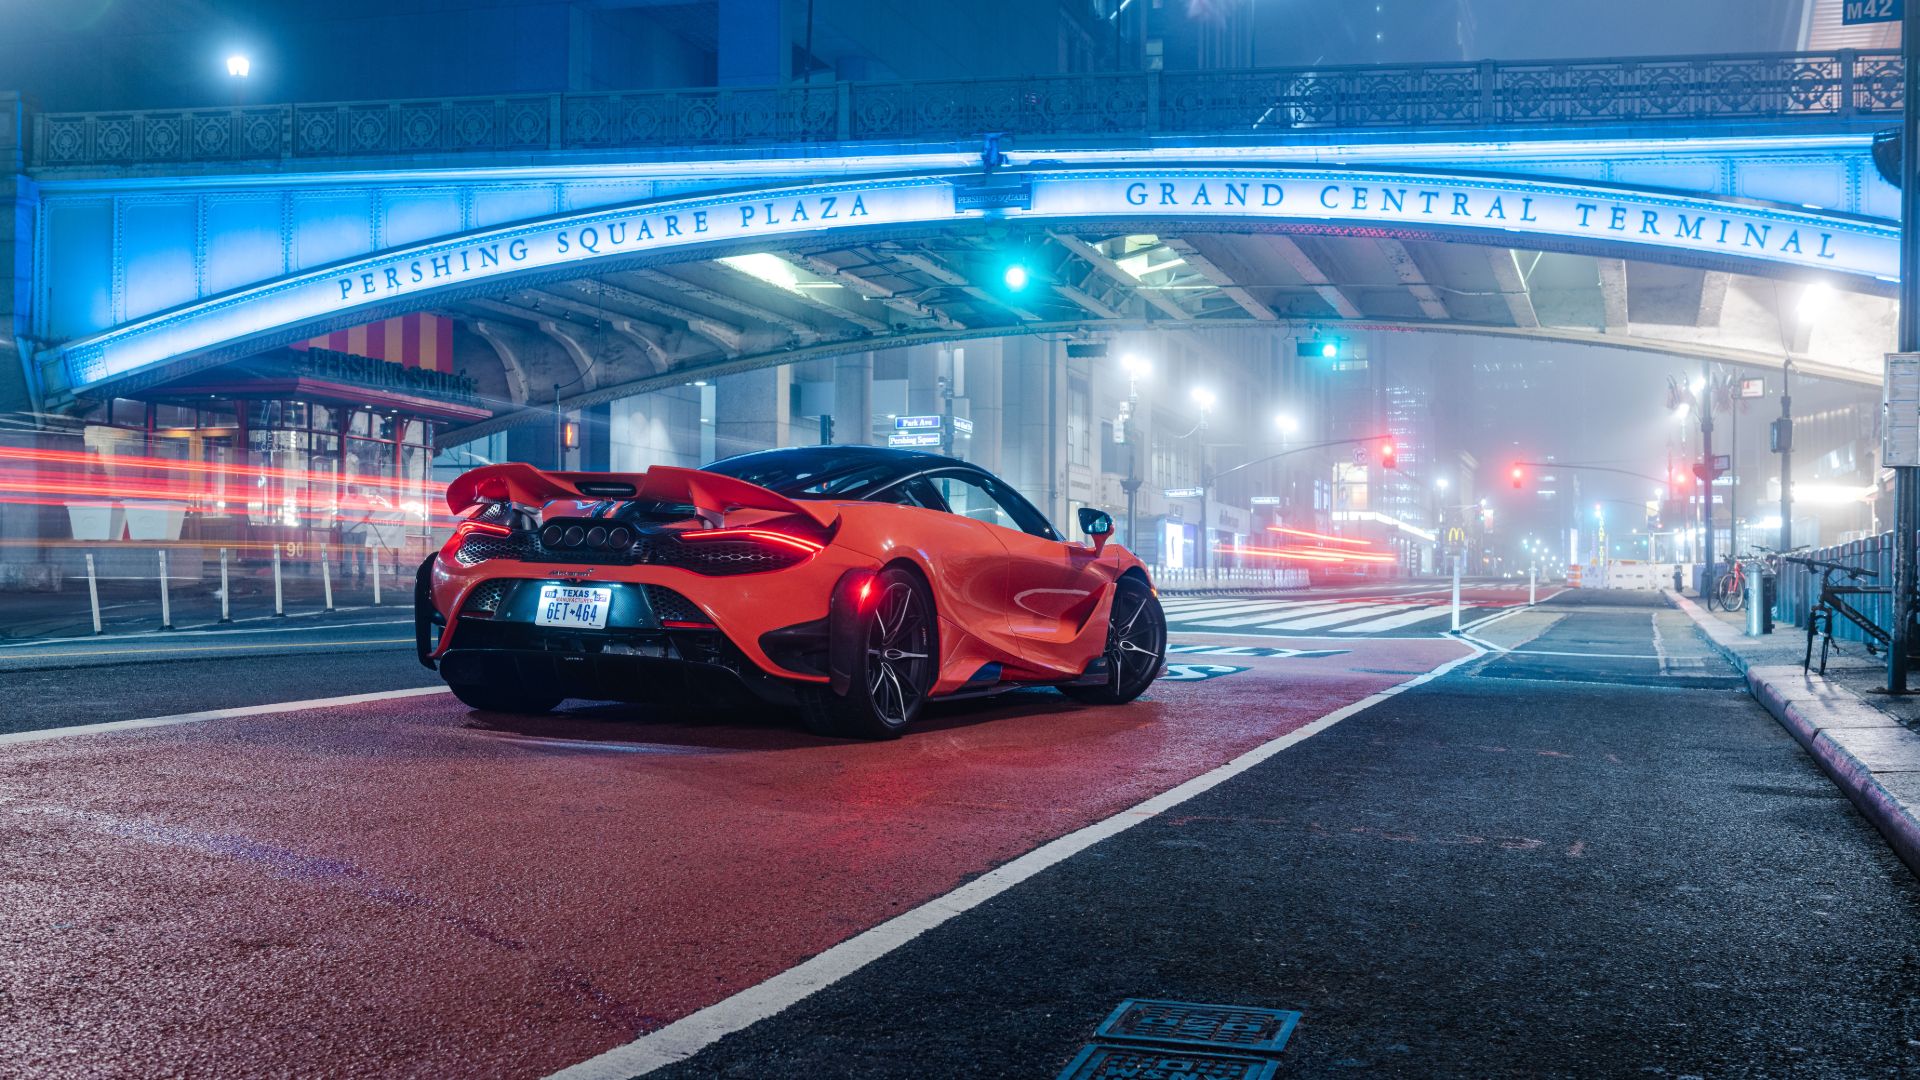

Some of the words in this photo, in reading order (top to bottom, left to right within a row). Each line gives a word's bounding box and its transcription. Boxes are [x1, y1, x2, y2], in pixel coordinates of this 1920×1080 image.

[1847, 0, 1893, 19] M42
[957, 194, 997, 204] PERSHING
[999, 193, 1029, 203] SQUARE
[1126, 183, 1284, 206] GRAND
[1320, 186, 1537, 222] CENTRAL
[1576, 203, 1835, 259] TERMINAL
[338, 239, 528, 300] PERSHING
[557, 211, 709, 253] SQUARE
[740, 194, 868, 227] PLAZA
[903, 418, 918, 427] Park
[919, 418, 933, 426] Ave
[286, 541, 304, 557] 90
[563, 589, 590, 598] TEXAS
[575, 603, 598, 622] 464
